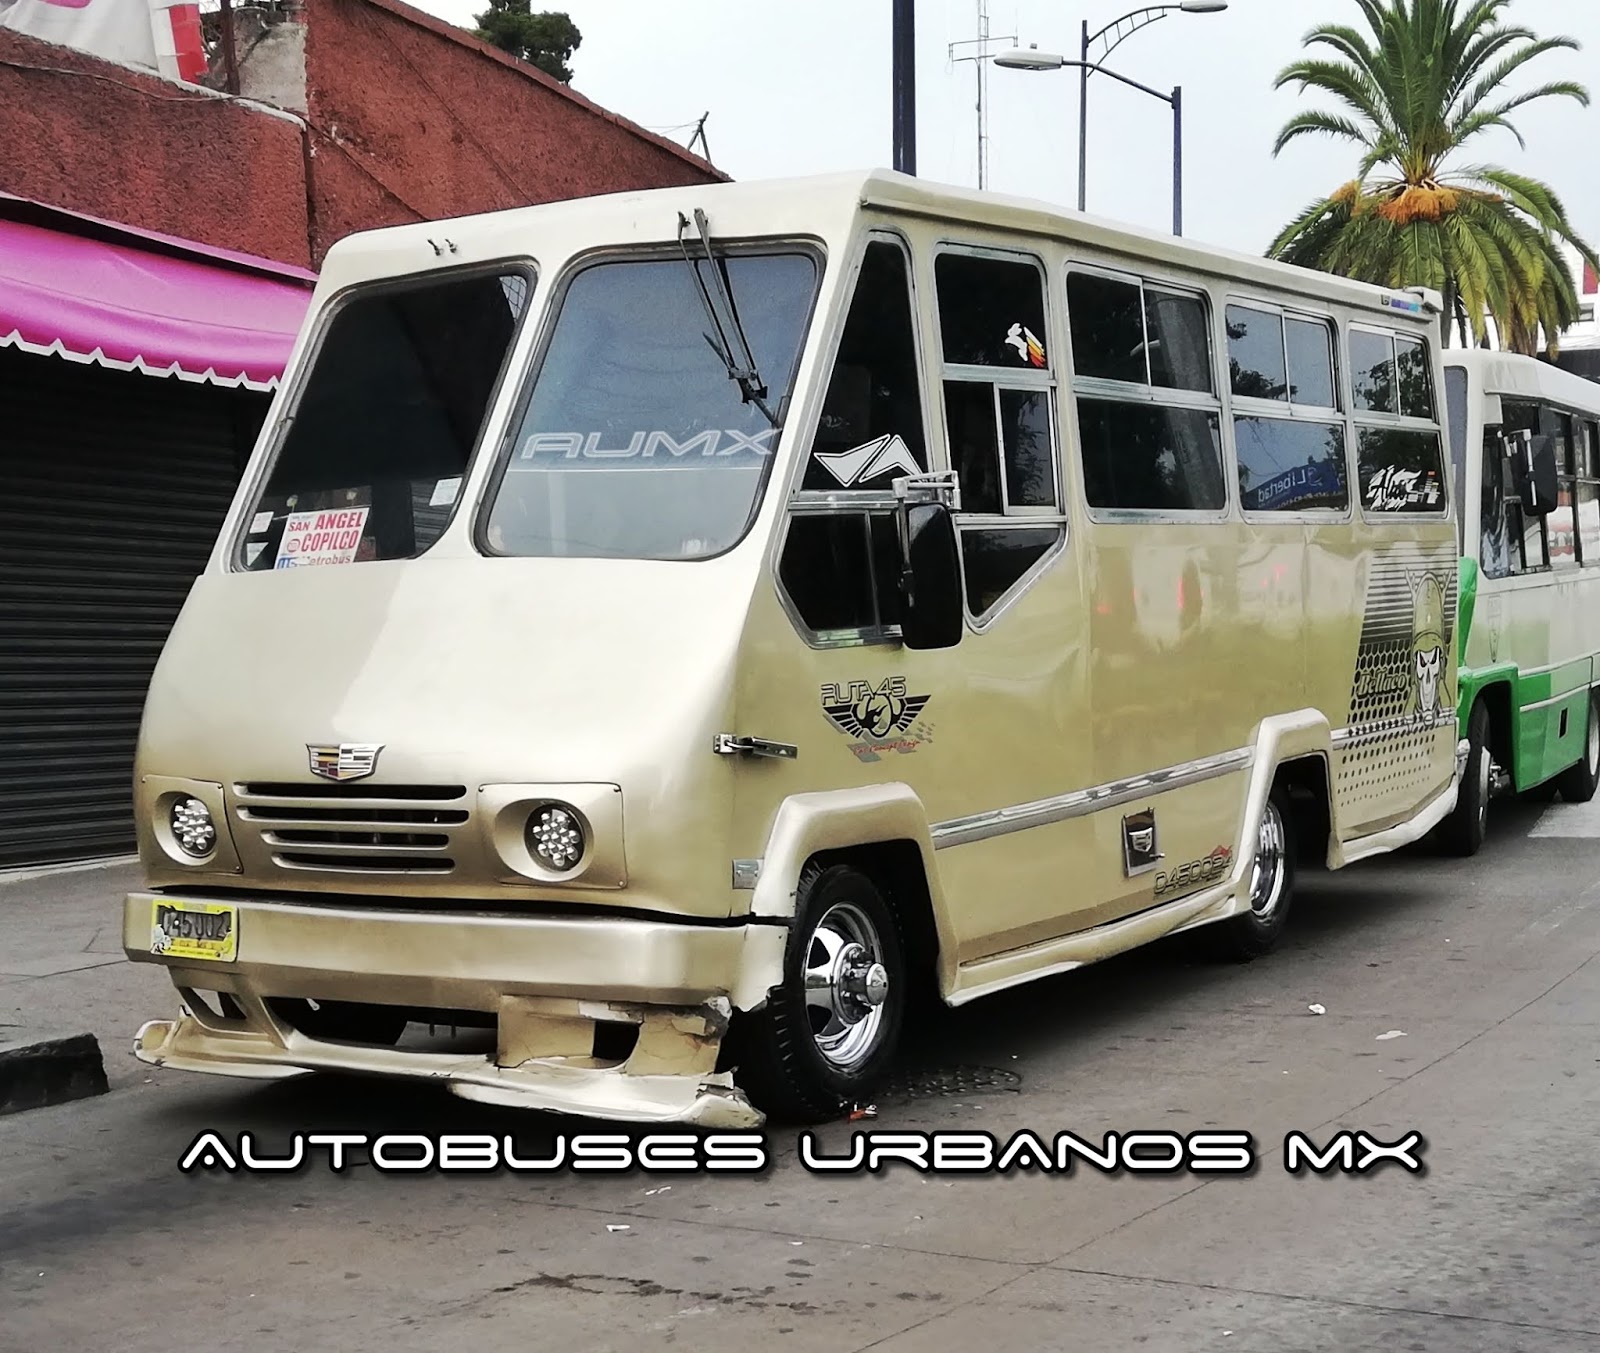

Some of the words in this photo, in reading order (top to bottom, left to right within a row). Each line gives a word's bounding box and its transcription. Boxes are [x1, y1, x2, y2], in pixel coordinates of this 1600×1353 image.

[520, 428, 782, 460] AUMX
[288, 521, 311, 532] SAN
[314, 511, 364, 531] ANGEL
[300, 530, 360, 552] COPILCO
[303, 553, 352, 567] etrobus
[1356, 667, 1408, 699] Bellaco
